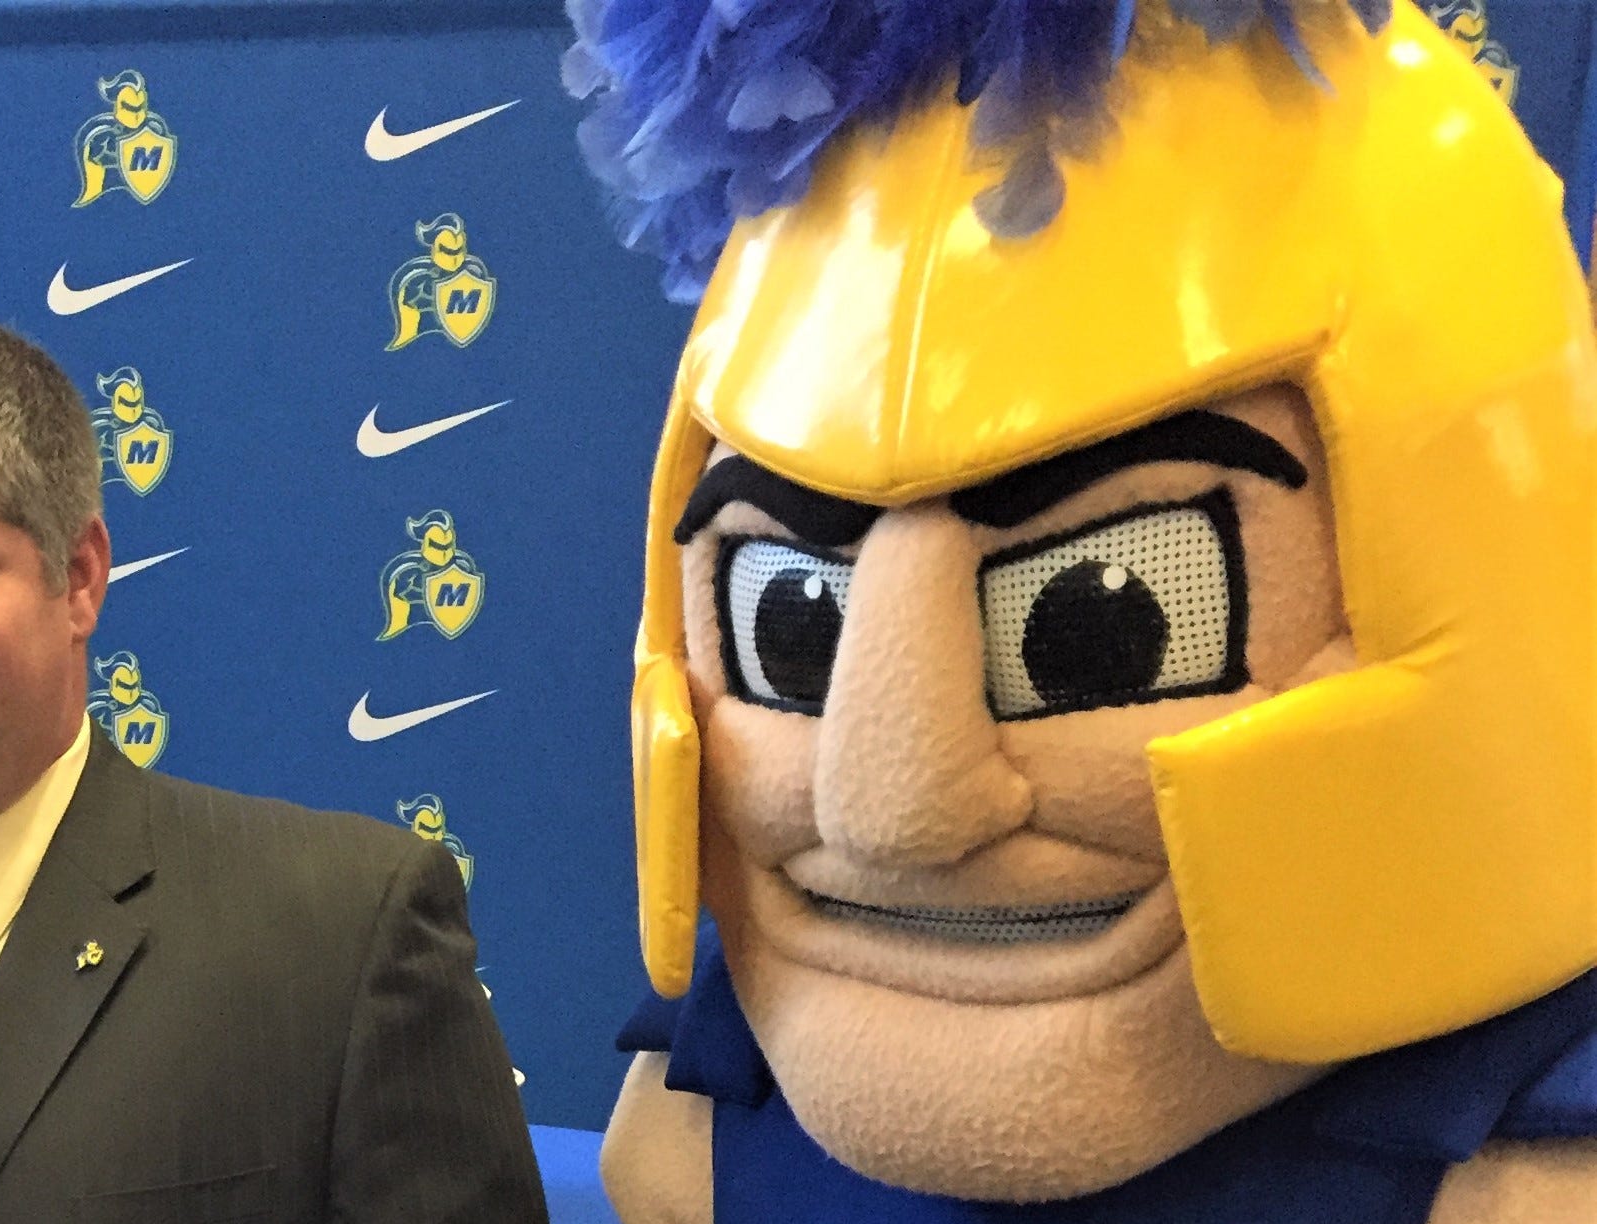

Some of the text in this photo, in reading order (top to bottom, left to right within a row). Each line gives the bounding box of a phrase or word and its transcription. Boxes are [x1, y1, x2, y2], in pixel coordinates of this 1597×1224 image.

[129, 146, 165, 173] M
[445, 288, 482, 315] M
[125, 441, 159, 466] M
[436, 581, 471, 607] M
[123, 721, 156, 745] M
